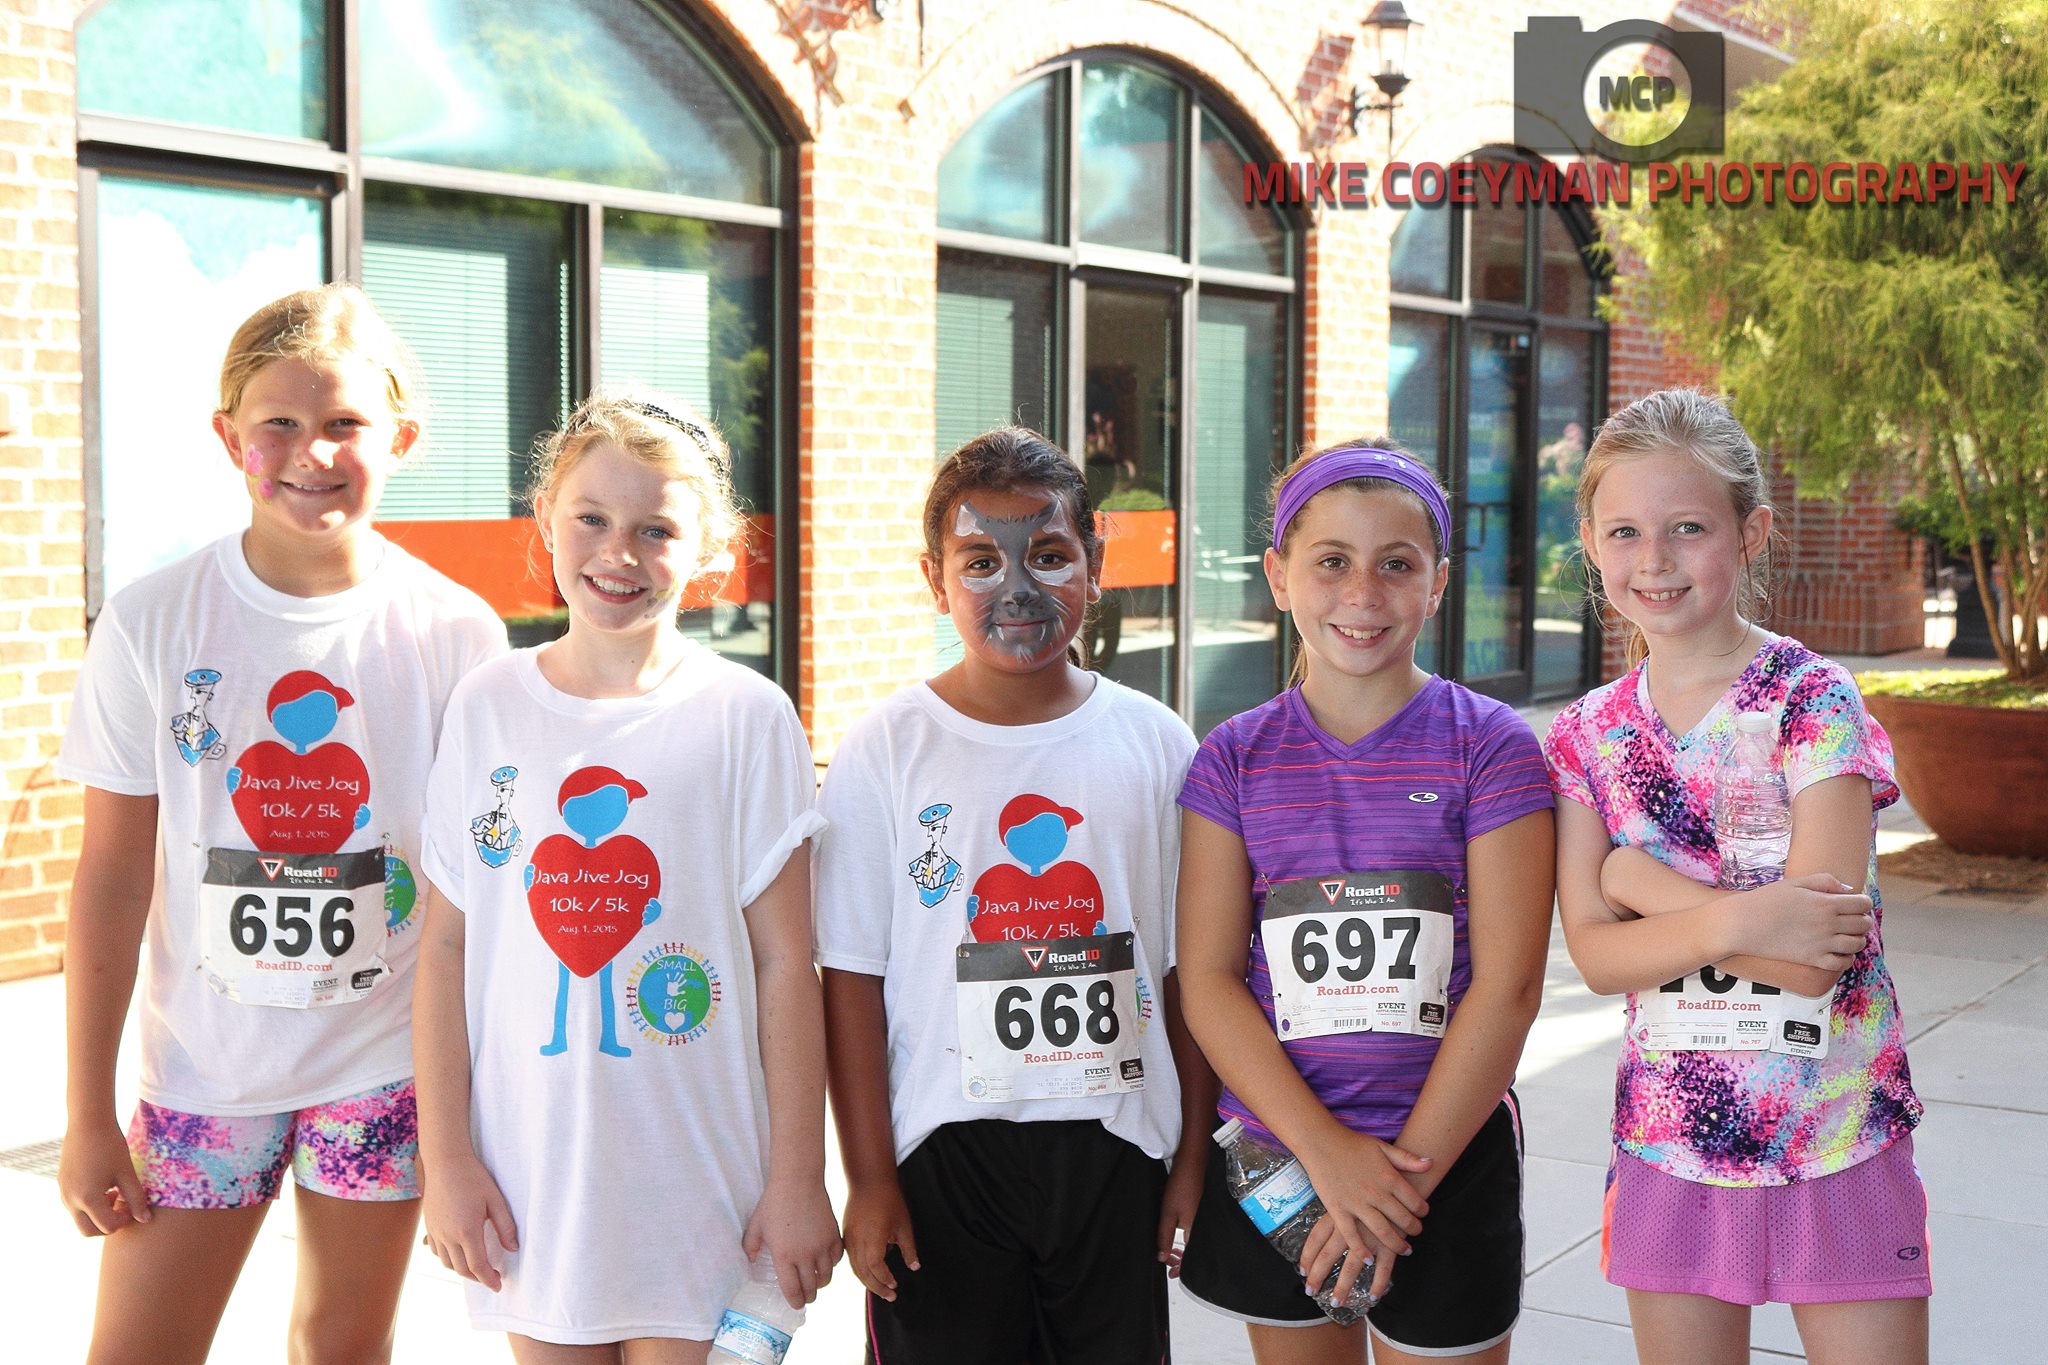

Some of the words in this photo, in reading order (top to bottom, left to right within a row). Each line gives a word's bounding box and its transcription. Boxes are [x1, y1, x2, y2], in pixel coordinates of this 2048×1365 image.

[242, 774, 280, 790] Java
[286, 776, 322, 790] Jive
[326, 776, 360, 796] Jog
[260, 802, 296, 818] 10k
[300, 804, 313, 818] /
[318, 804, 342, 818] 5k
[306, 830, 330, 838] 2015
[284, 866, 338, 878] RoadID
[536, 870, 568, 884] Java
[574, 868, 610, 884] Jive
[614, 870, 648, 890] Jog
[1345, 884, 1400, 897] RoadID
[550, 896, 584, 912] 10k
[588, 897, 600, 912] /
[604, 898, 630, 912] 5k
[982, 900, 1020, 914] Java
[1024, 897, 1060, 912] Jive
[1064, 895, 1094, 913] Jog
[230, 894, 354, 958] 656
[592, 925, 618, 933] 2015
[1001, 924, 1038, 940] 10k
[1042, 924, 1053, 940] /
[1059, 922, 1080, 938] 5k
[1048, 949, 1101, 963] RoadID
[1291, 917, 1421, 984] 697
[255, 960, 332, 971] RoadID.com
[657, 960, 696, 972] SMALL
[313, 978, 338, 987] EVENT
[1317, 984, 1399, 996] RoadID.com
[664, 999, 687, 1011] BIG
[1677, 1000, 1761, 1011] RoadID.com
[994, 979, 1120, 1051] 668
[1024, 1050, 1104, 1064] RoadID.com
[1085, 1067, 1110, 1075] EVENT
